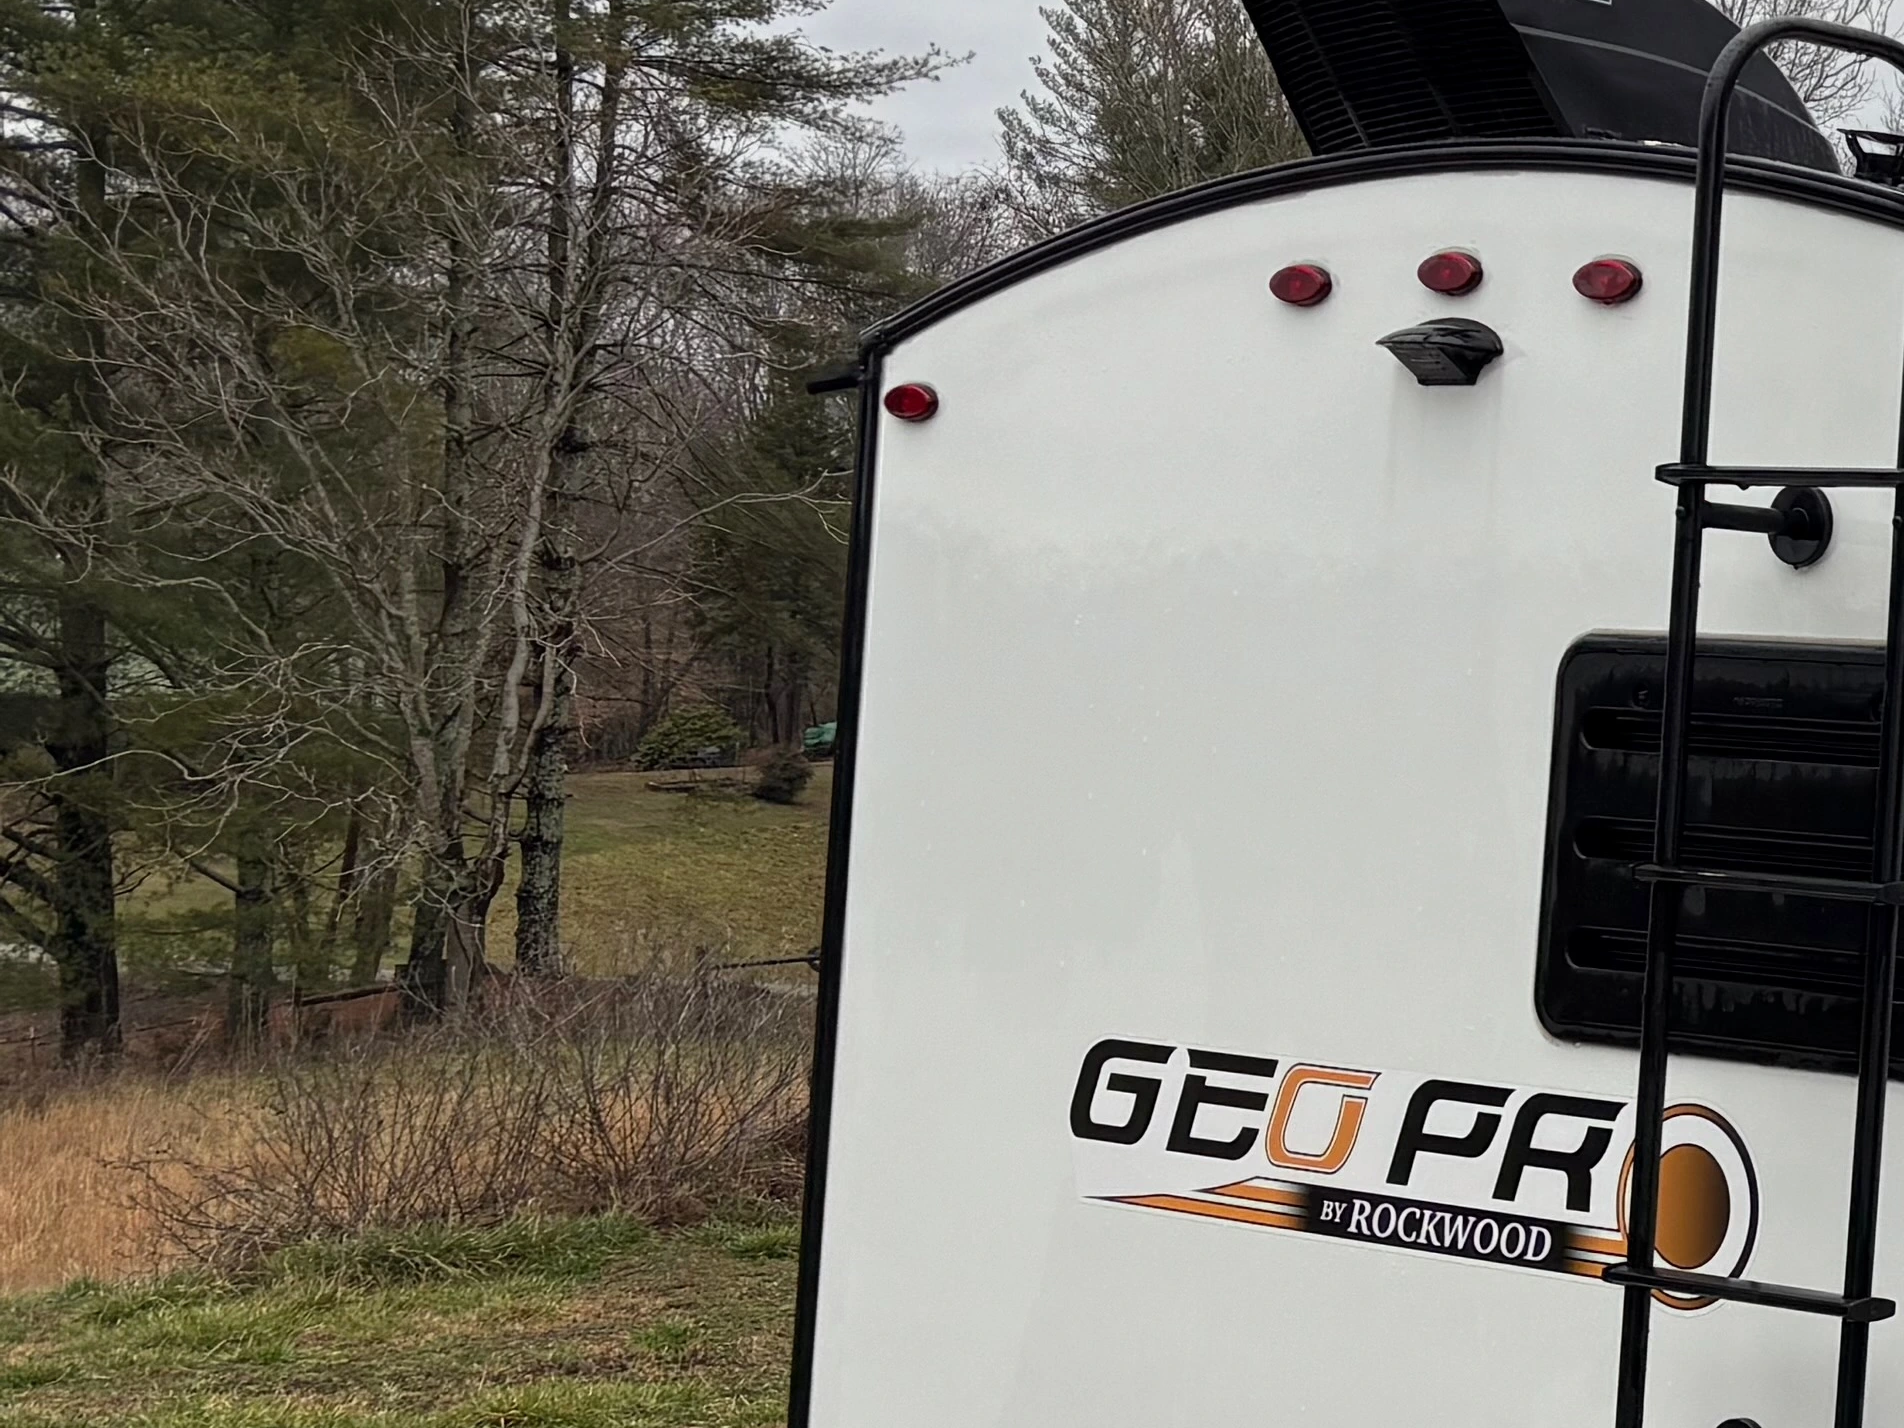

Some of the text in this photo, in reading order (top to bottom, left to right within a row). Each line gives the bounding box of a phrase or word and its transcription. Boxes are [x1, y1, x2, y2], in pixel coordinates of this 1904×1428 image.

[1069, 1038, 1383, 1175] GEO
[1319, 1197, 1553, 1264] BY ROCKWOOD
